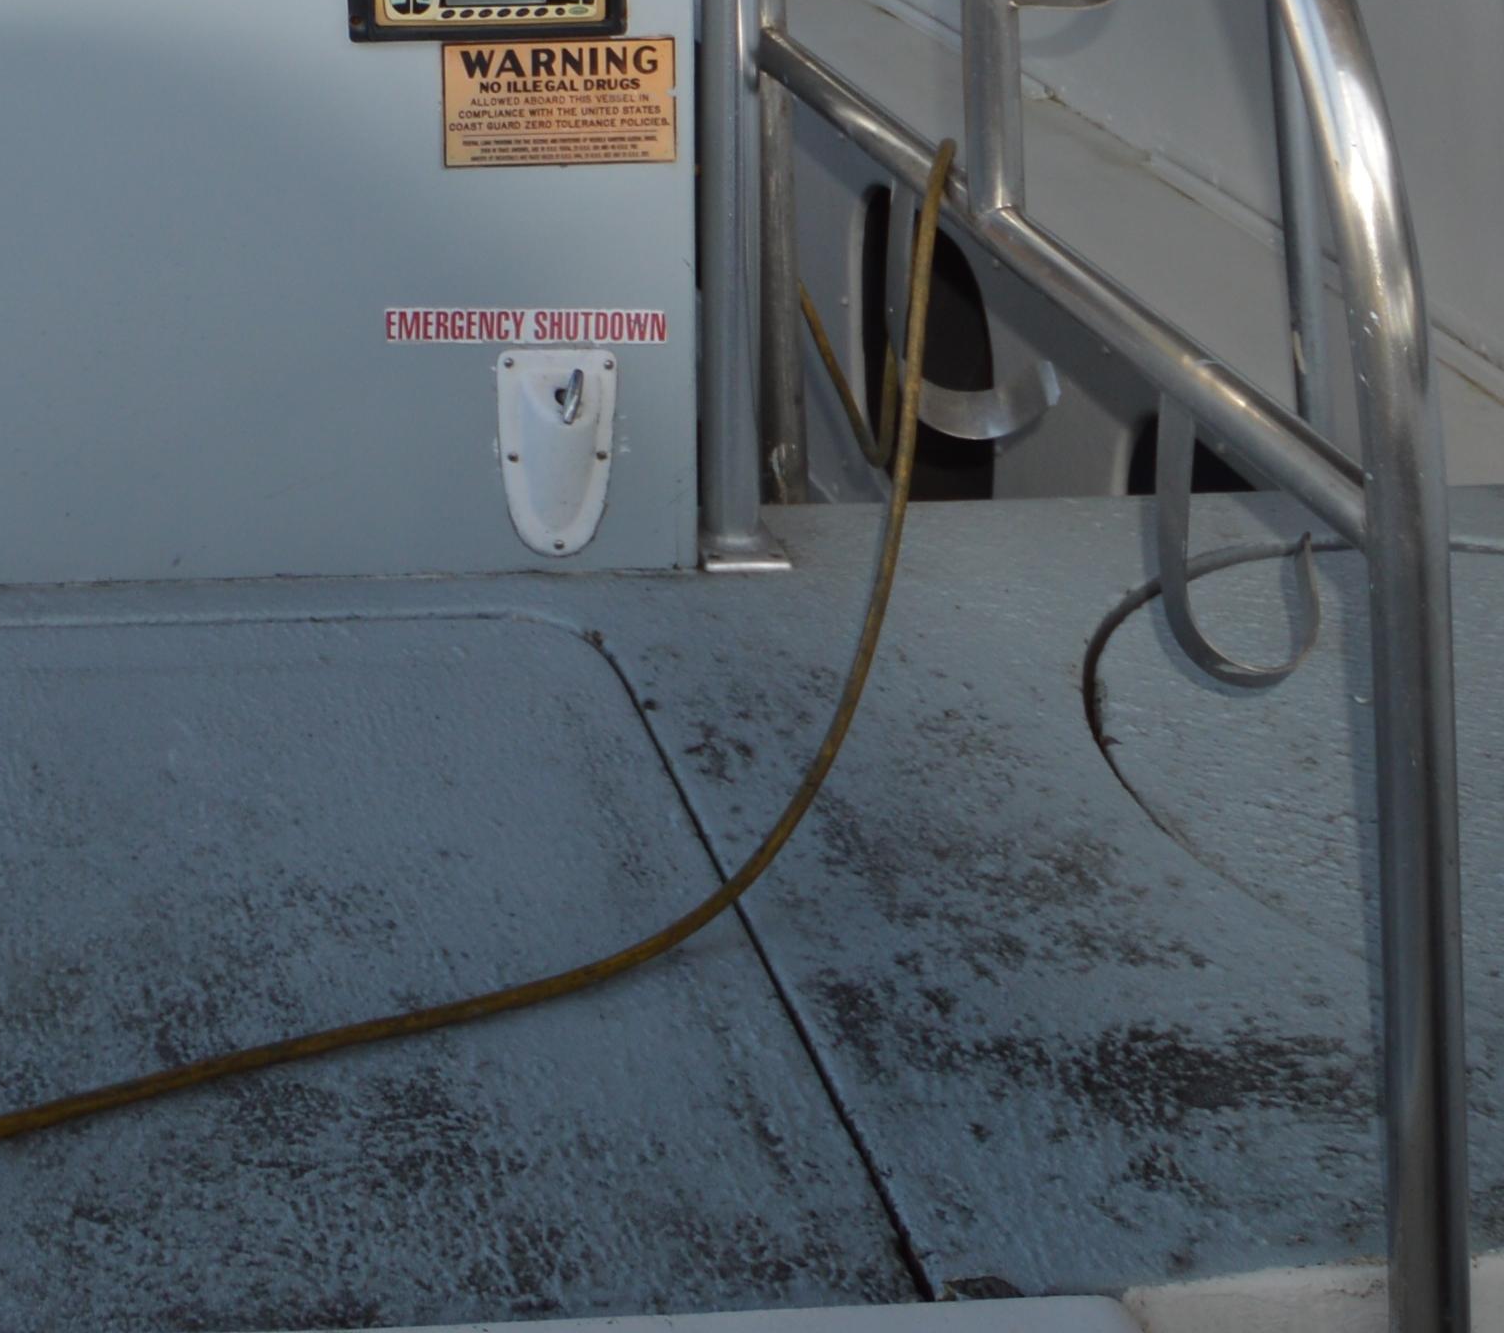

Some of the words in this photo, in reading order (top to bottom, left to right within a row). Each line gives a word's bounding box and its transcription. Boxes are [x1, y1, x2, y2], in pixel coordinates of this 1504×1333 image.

[460, 46, 658, 79] WARNING
[480, 81, 501, 94] NO
[507, 79, 578, 93] ILLEGAL
[583, 78, 640, 91] DRUGS
[470, 97, 520, 106] ALLOWED
[524, 96, 565, 105] ABOARD
[569, 95, 592, 104] THIS
[596, 94, 635, 103] VESSEL
[639, 94, 649, 102] IN
[458, 108, 525, 119] COMPLIANCE
[529, 107, 553, 117] WITH
[557, 107, 577, 117] THE
[582, 106, 618, 116] UNITED
[622, 105, 661, 115] STATES
[449, 121, 482, 132] COAST
[487, 120, 520, 130] GUARD
[525, 120, 551, 129] ZERO
[556, 118, 616, 129] TOLERANCE
[385, 311, 525, 341] EMERGENCY
[534, 311, 666, 341] SHUTDOWN
